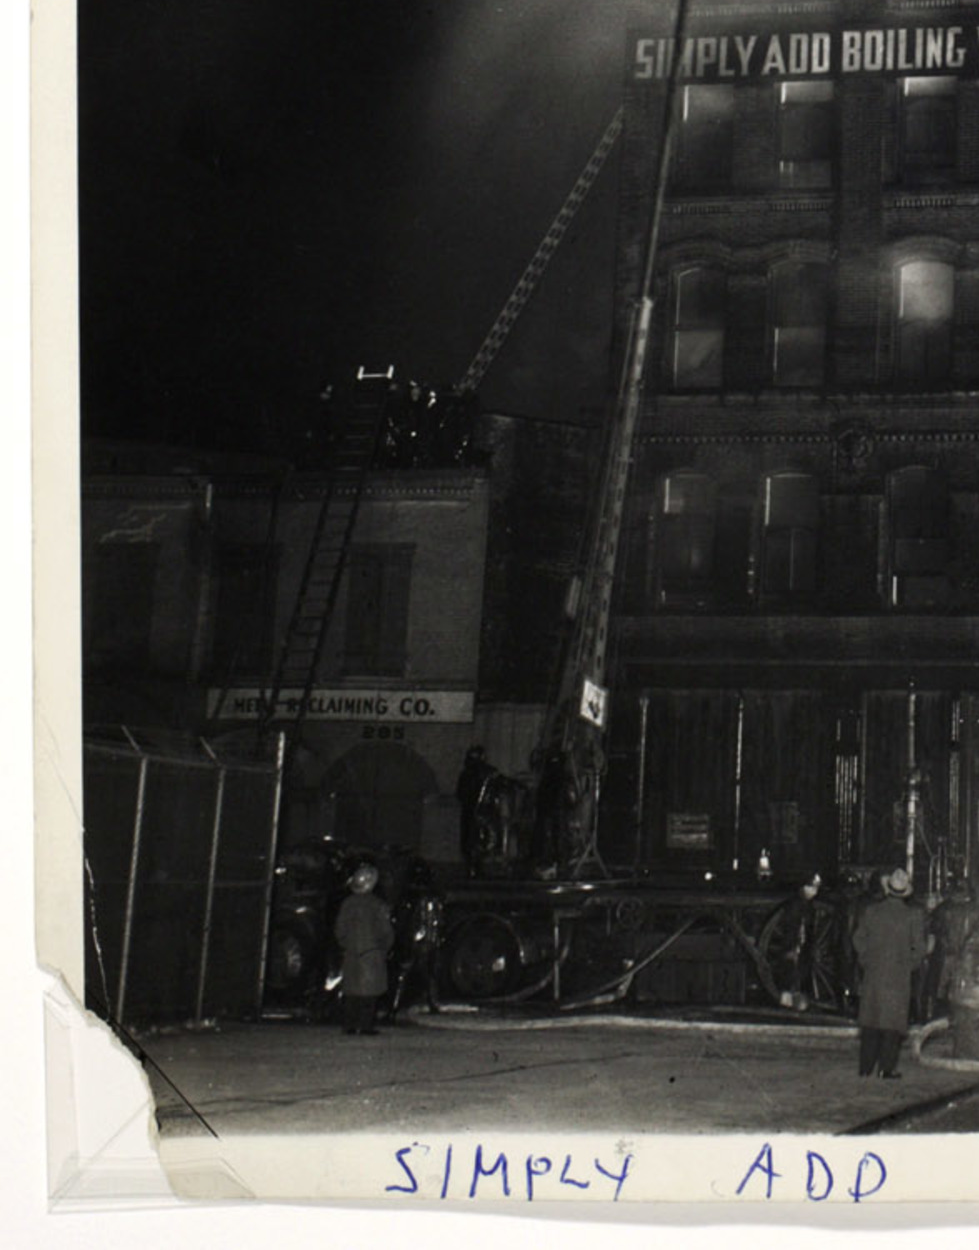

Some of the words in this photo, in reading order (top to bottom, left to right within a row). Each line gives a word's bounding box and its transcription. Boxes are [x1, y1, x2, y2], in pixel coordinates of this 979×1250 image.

[635, 34, 758, 79] SIMPLY
[761, 31, 831, 76] ADD
[842, 26, 966, 73] BOILING
[399, 697, 436, 716] CO.
[385, 1142, 634, 1202] SIMPLY
[736, 1142, 888, 1203] ADD
